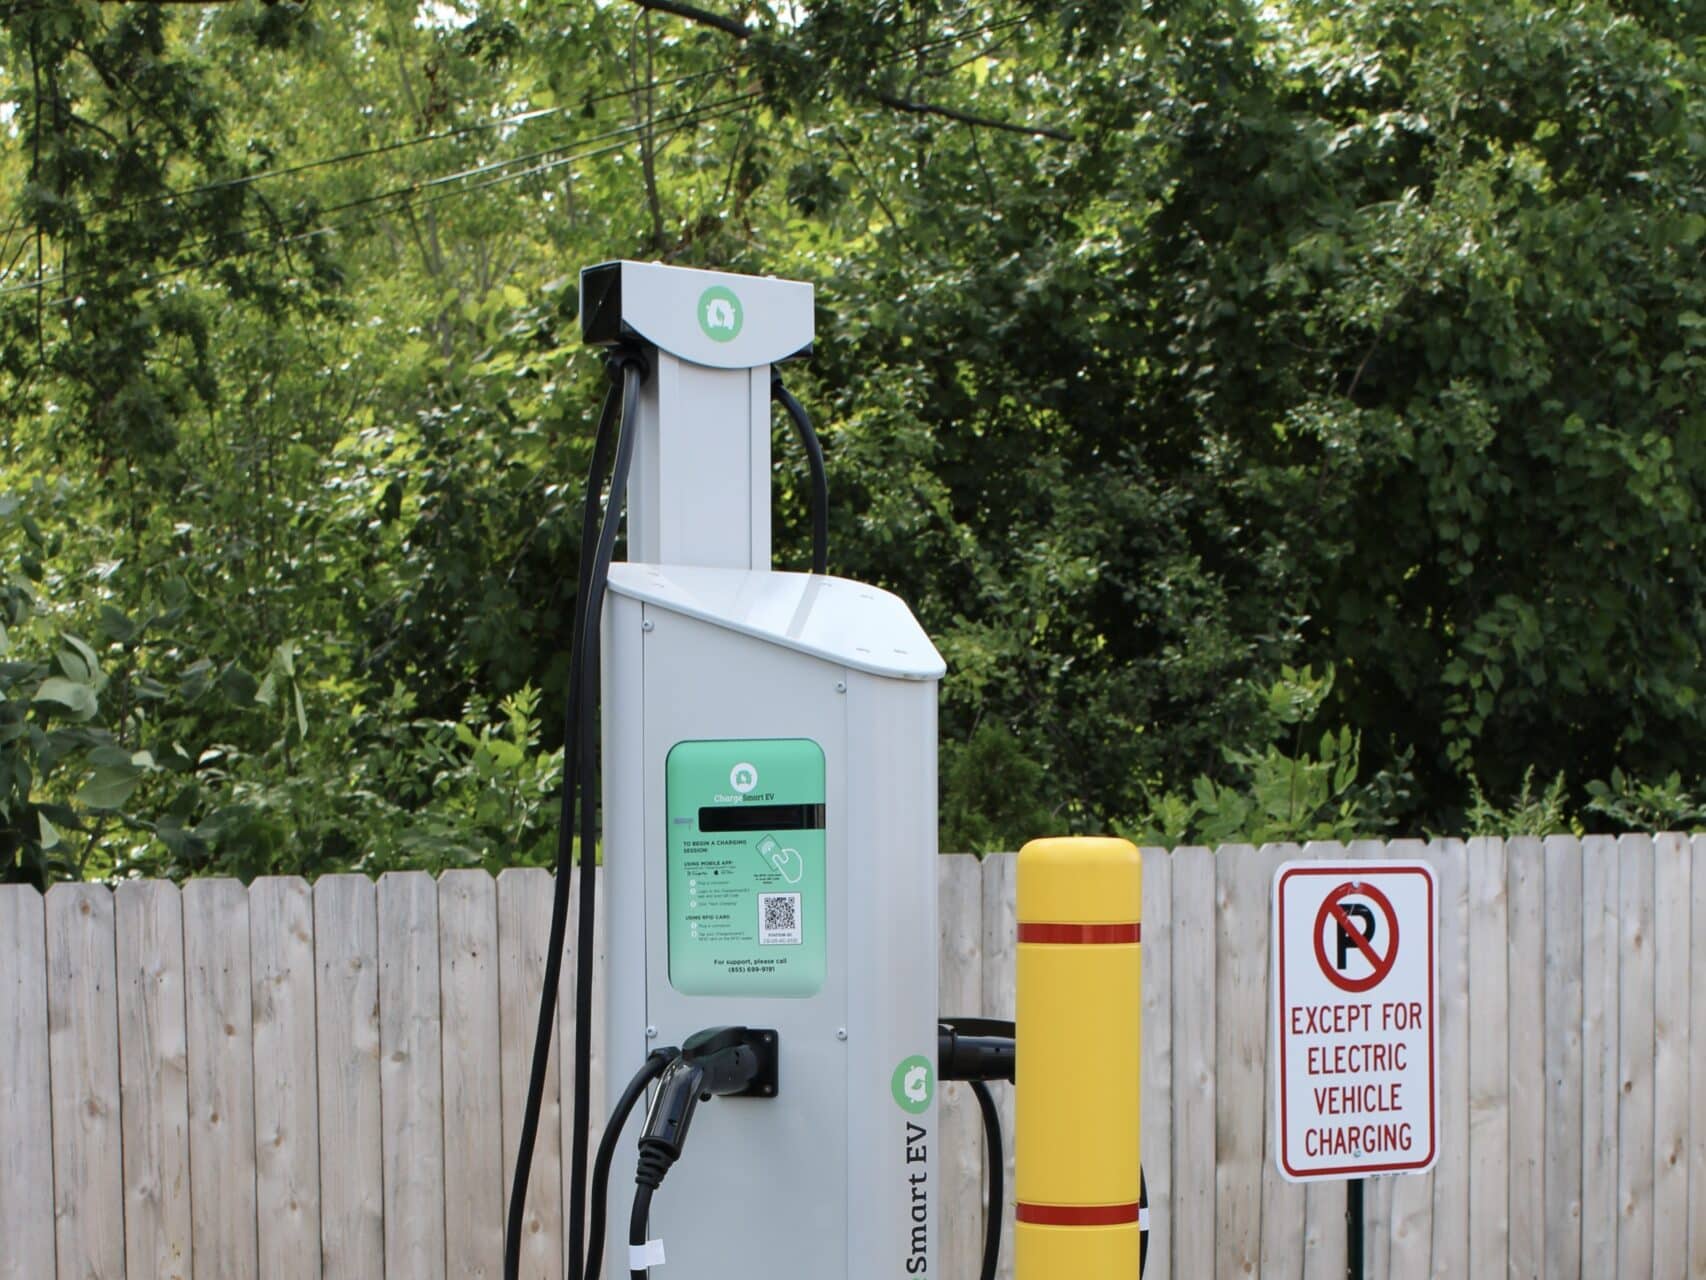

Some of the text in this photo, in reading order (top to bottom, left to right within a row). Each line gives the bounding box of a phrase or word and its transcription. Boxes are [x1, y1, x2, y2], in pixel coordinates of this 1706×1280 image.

[765, 792, 775, 801] EV
[754, 958, 774, 966] please
[1291, 1001, 1422, 1035] EXCEPT FOR
[1307, 1043, 1407, 1075] ELECTRIC
[1313, 1083, 1402, 1115] VEHICLE
[906, 1120, 928, 1164] EV
[1304, 1123, 1412, 1157] CHARGING
